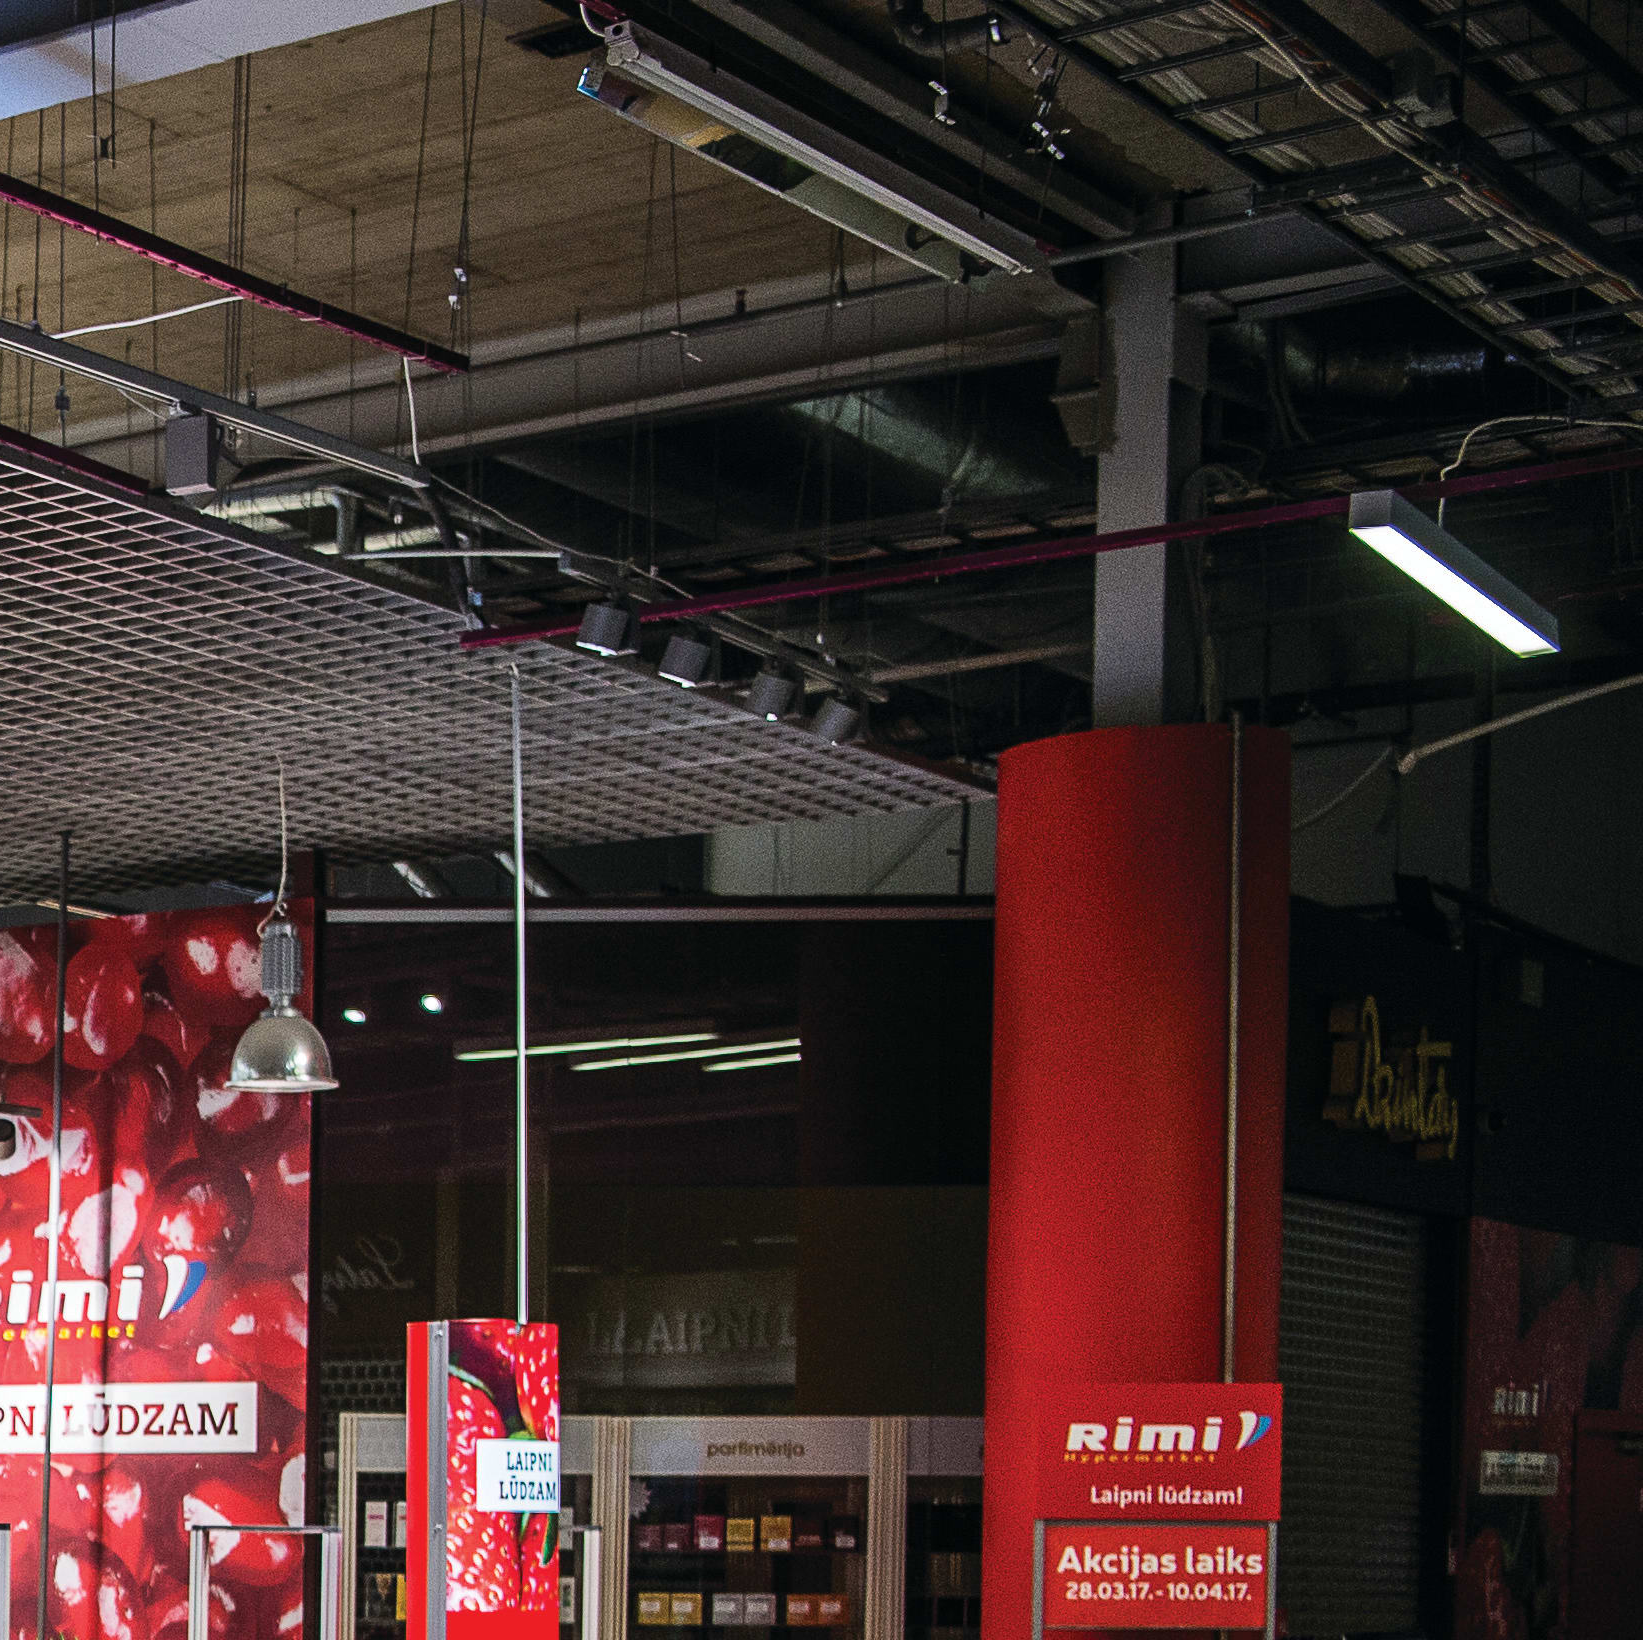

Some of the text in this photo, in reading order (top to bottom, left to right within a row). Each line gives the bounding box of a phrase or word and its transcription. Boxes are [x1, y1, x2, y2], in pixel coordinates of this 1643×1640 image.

[62, 1391, 239, 1437] LŪDZAM
[1067, 1416, 1223, 1451] Rimi
[505, 1450, 553, 1473] LAIPNI
[1064, 1452, 1216, 1464] Hypermarket
[499, 1475, 557, 1501] LŪDZAM
[1090, 1485, 1243, 1509] Laipni lūdzam!
[1057, 1545, 1263, 1581] Akcijas laiks
